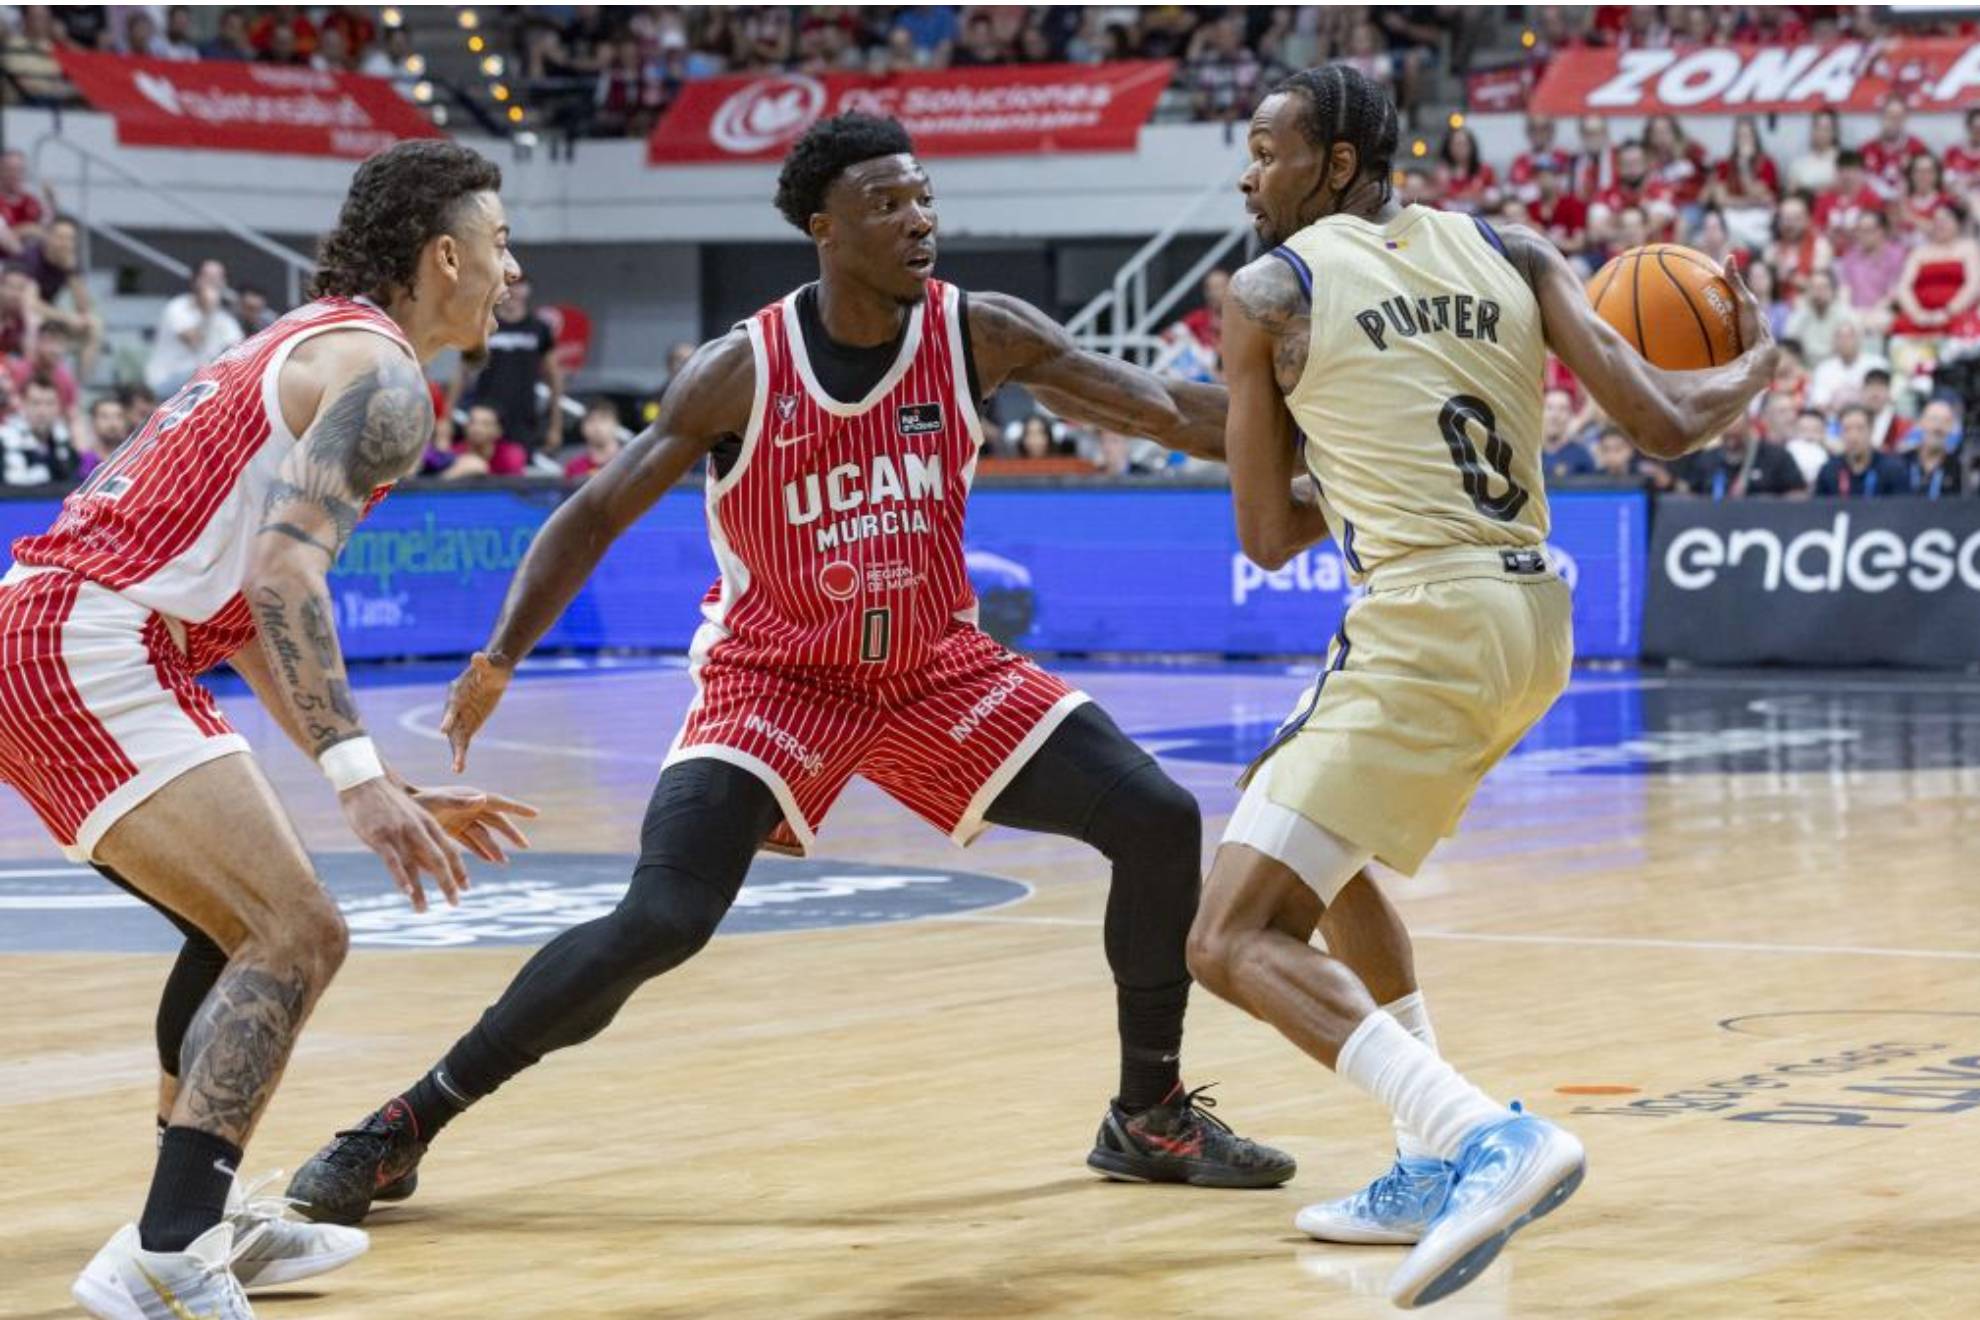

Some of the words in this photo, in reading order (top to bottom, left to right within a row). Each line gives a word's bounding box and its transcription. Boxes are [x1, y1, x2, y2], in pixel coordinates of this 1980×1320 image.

[1586, 41, 1862, 107] ZONA
[784, 454, 944, 526] UCAM
[1438, 395, 1529, 522] 0
[816, 509, 930, 552] MURCIA
[1232, 541, 1362, 604] pela
[861, 607, 891, 664] 0
[948, 671, 1025, 744] INVERSUS
[744, 712, 825, 778] INVERSUS
